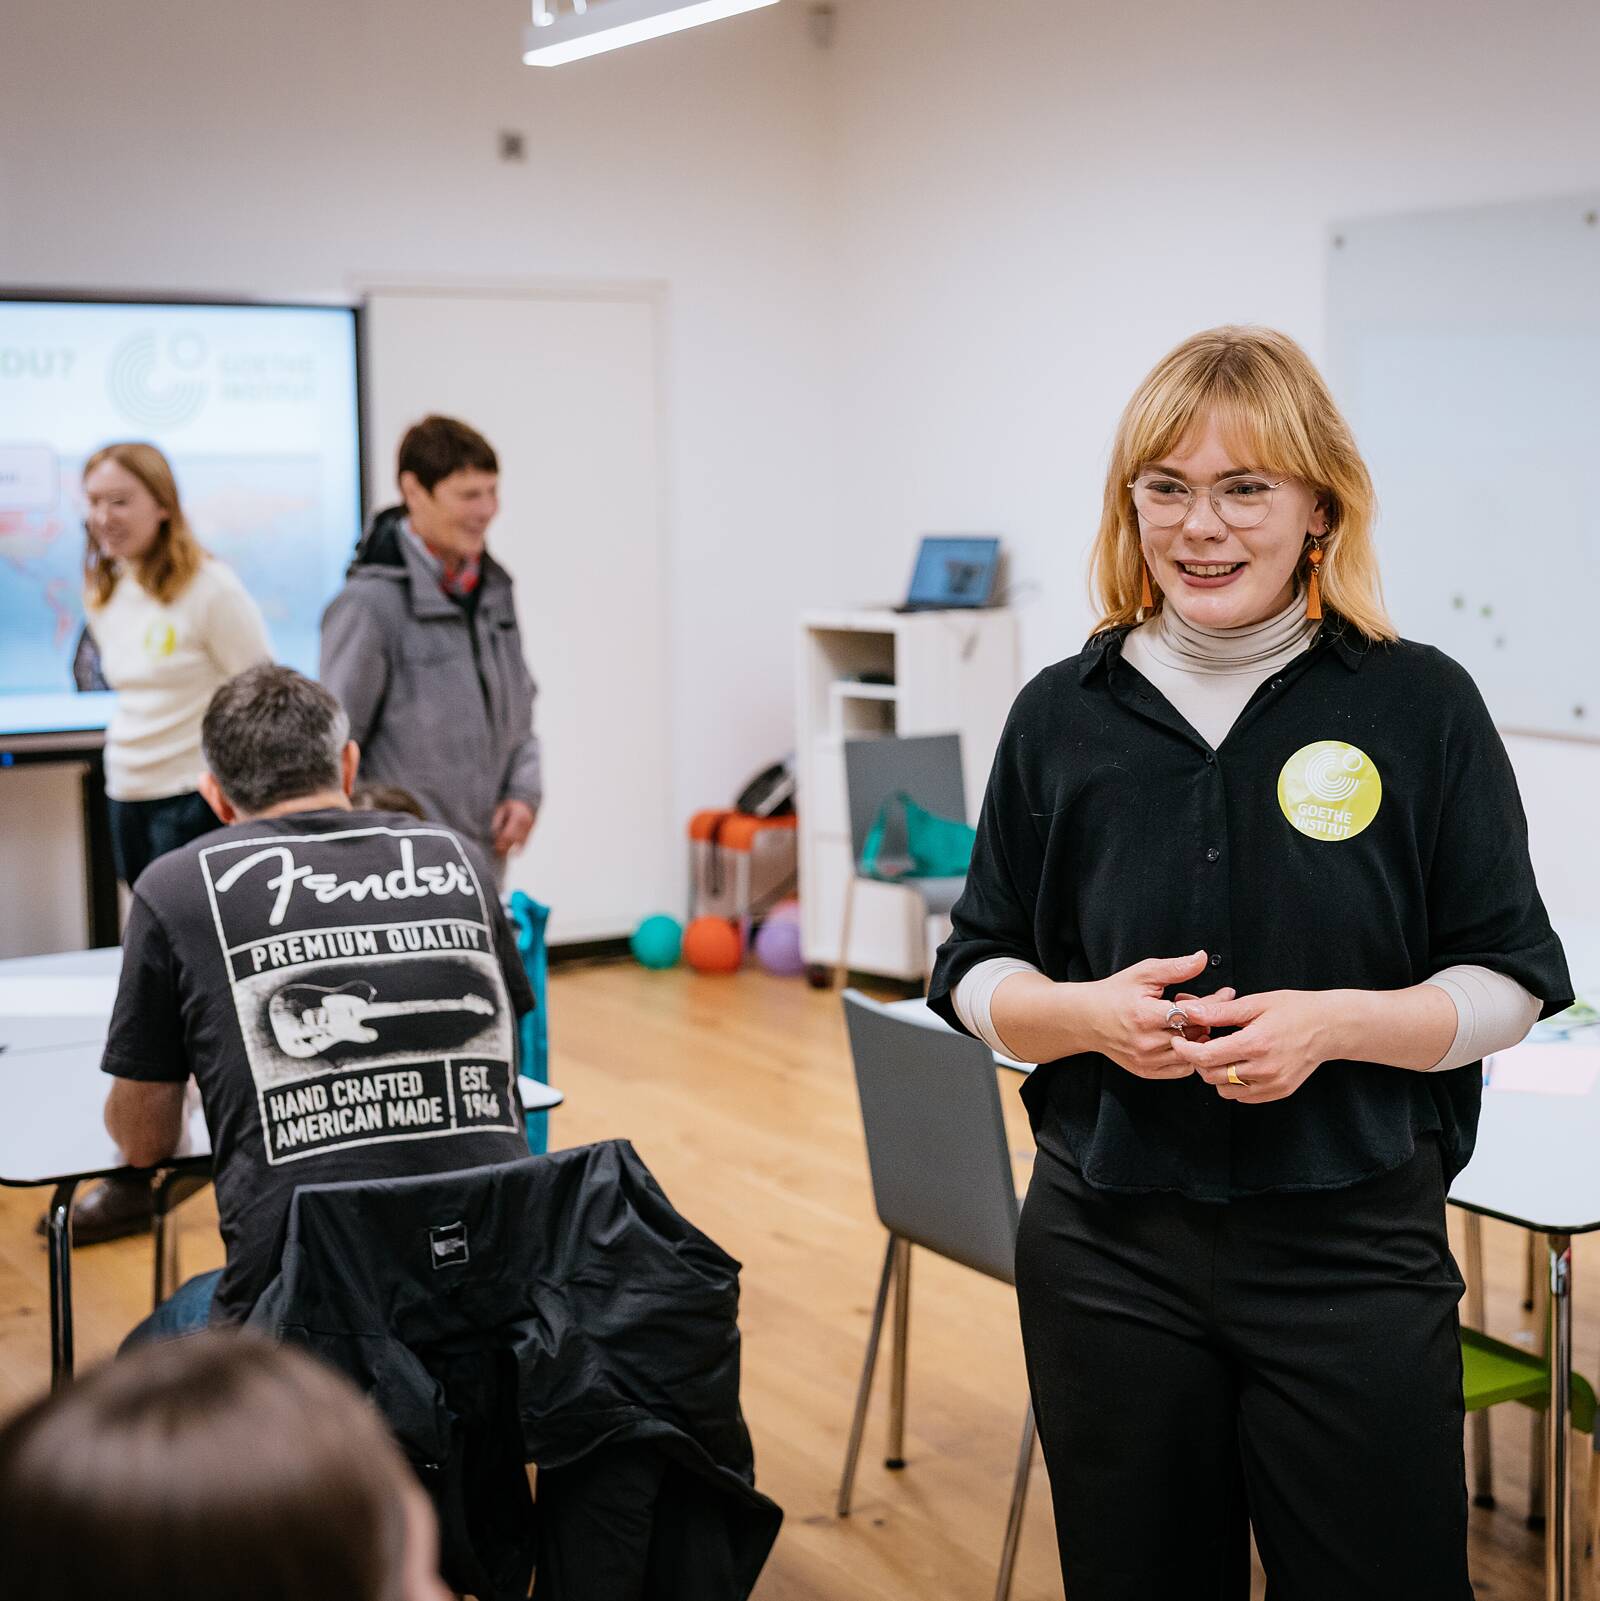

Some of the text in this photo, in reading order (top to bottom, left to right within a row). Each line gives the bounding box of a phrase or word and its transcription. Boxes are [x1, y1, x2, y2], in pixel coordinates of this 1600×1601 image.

[1294, 816, 1350, 837] INSTITUT
[1298, 803, 1352, 825] GOETHE
[215, 838, 475, 926] Fender
[251, 925, 479, 972] PREMIUM QUALITY
[269, 1070, 423, 1122] HAND CRAFTED
[459, 1065, 491, 1091] EST.
[276, 1096, 444, 1150] AMERICAN MADE
